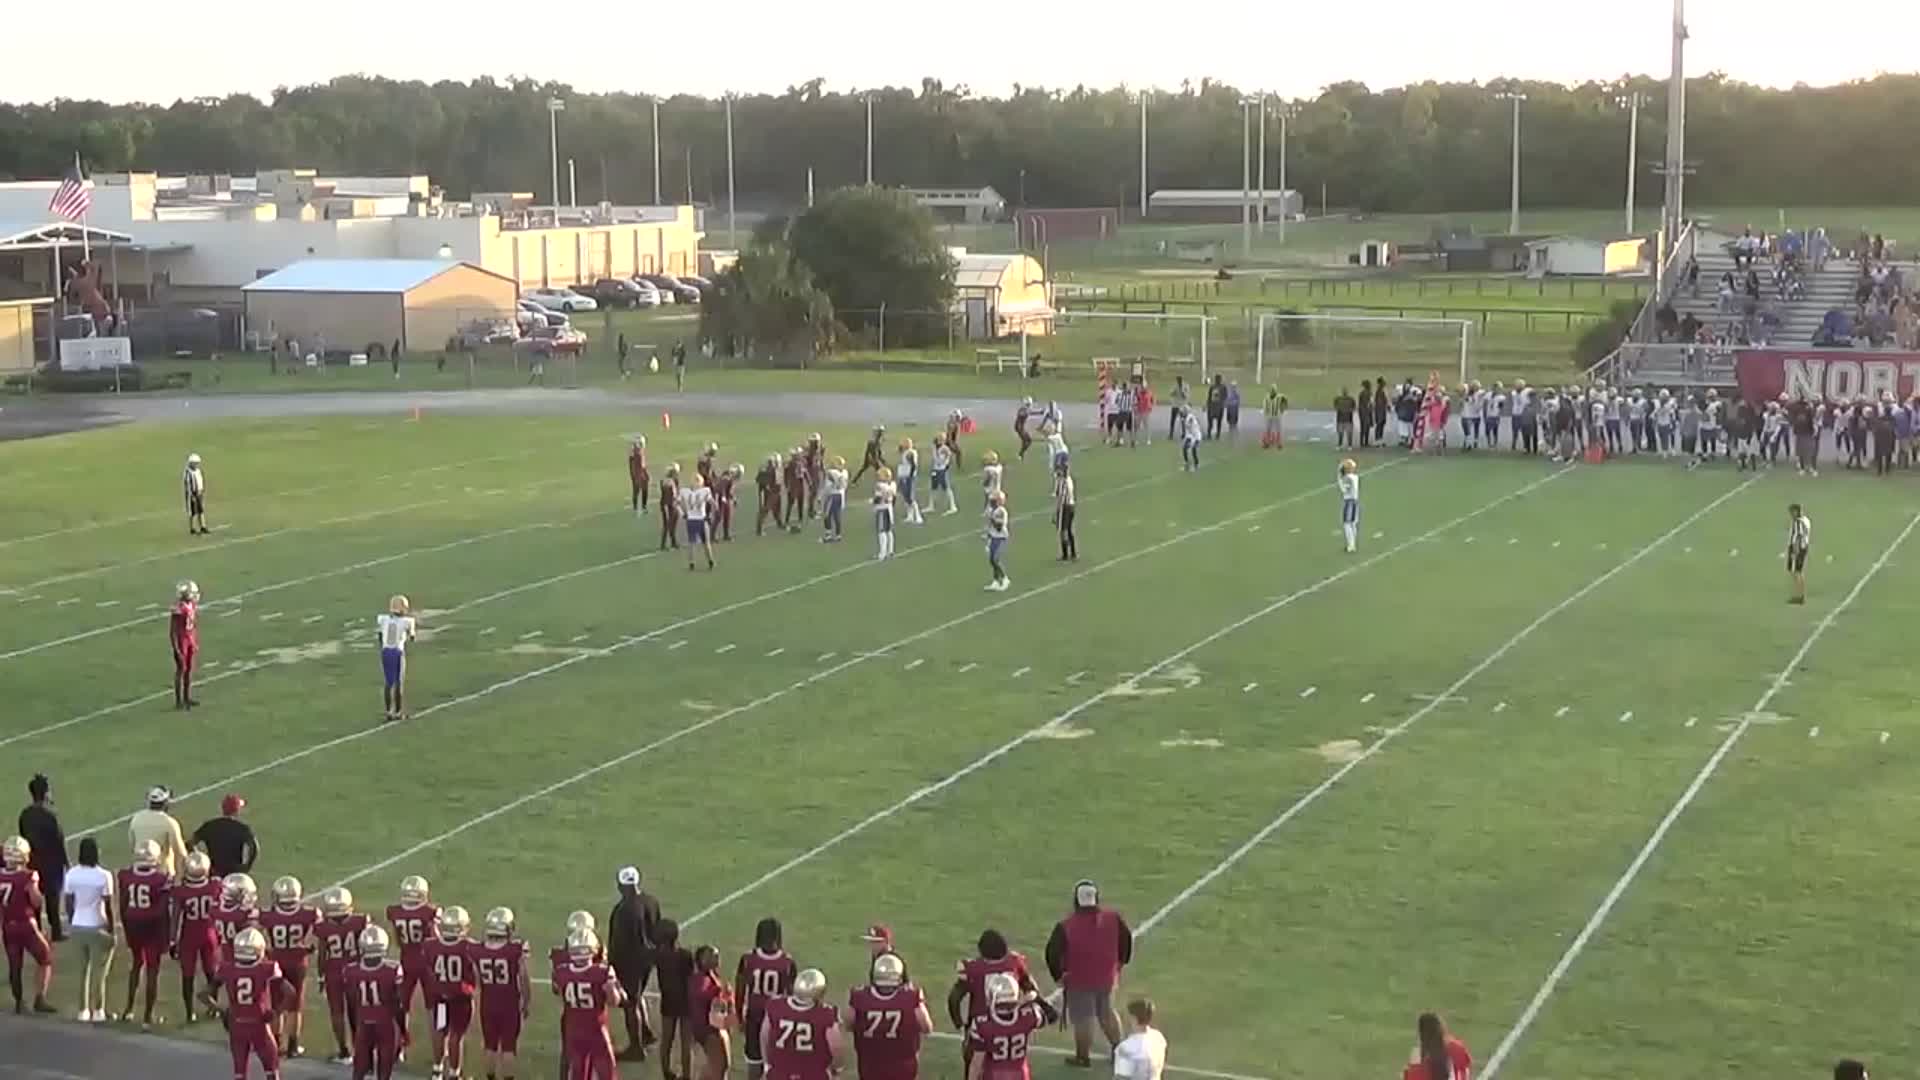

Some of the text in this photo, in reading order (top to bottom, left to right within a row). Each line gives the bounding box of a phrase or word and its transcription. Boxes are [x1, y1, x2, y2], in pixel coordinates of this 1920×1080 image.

[127, 883, 151, 909] 16
[185, 895, 213, 920] 30
[272, 924, 304, 949] 82
[327, 931, 357, 959] 24
[395, 919, 423, 944] 36
[434, 954, 462, 982] 40
[479, 958, 509, 985] 53
[236, 977, 253, 1004] 2
[359, 980, 381, 1007] 11
[565, 981, 594, 1009] 45
[752, 968, 780, 996] 10
[776, 1019, 813, 1051] 72
[863, 1010, 902, 1039] 77
[992, 1033, 1027, 1061] 32
